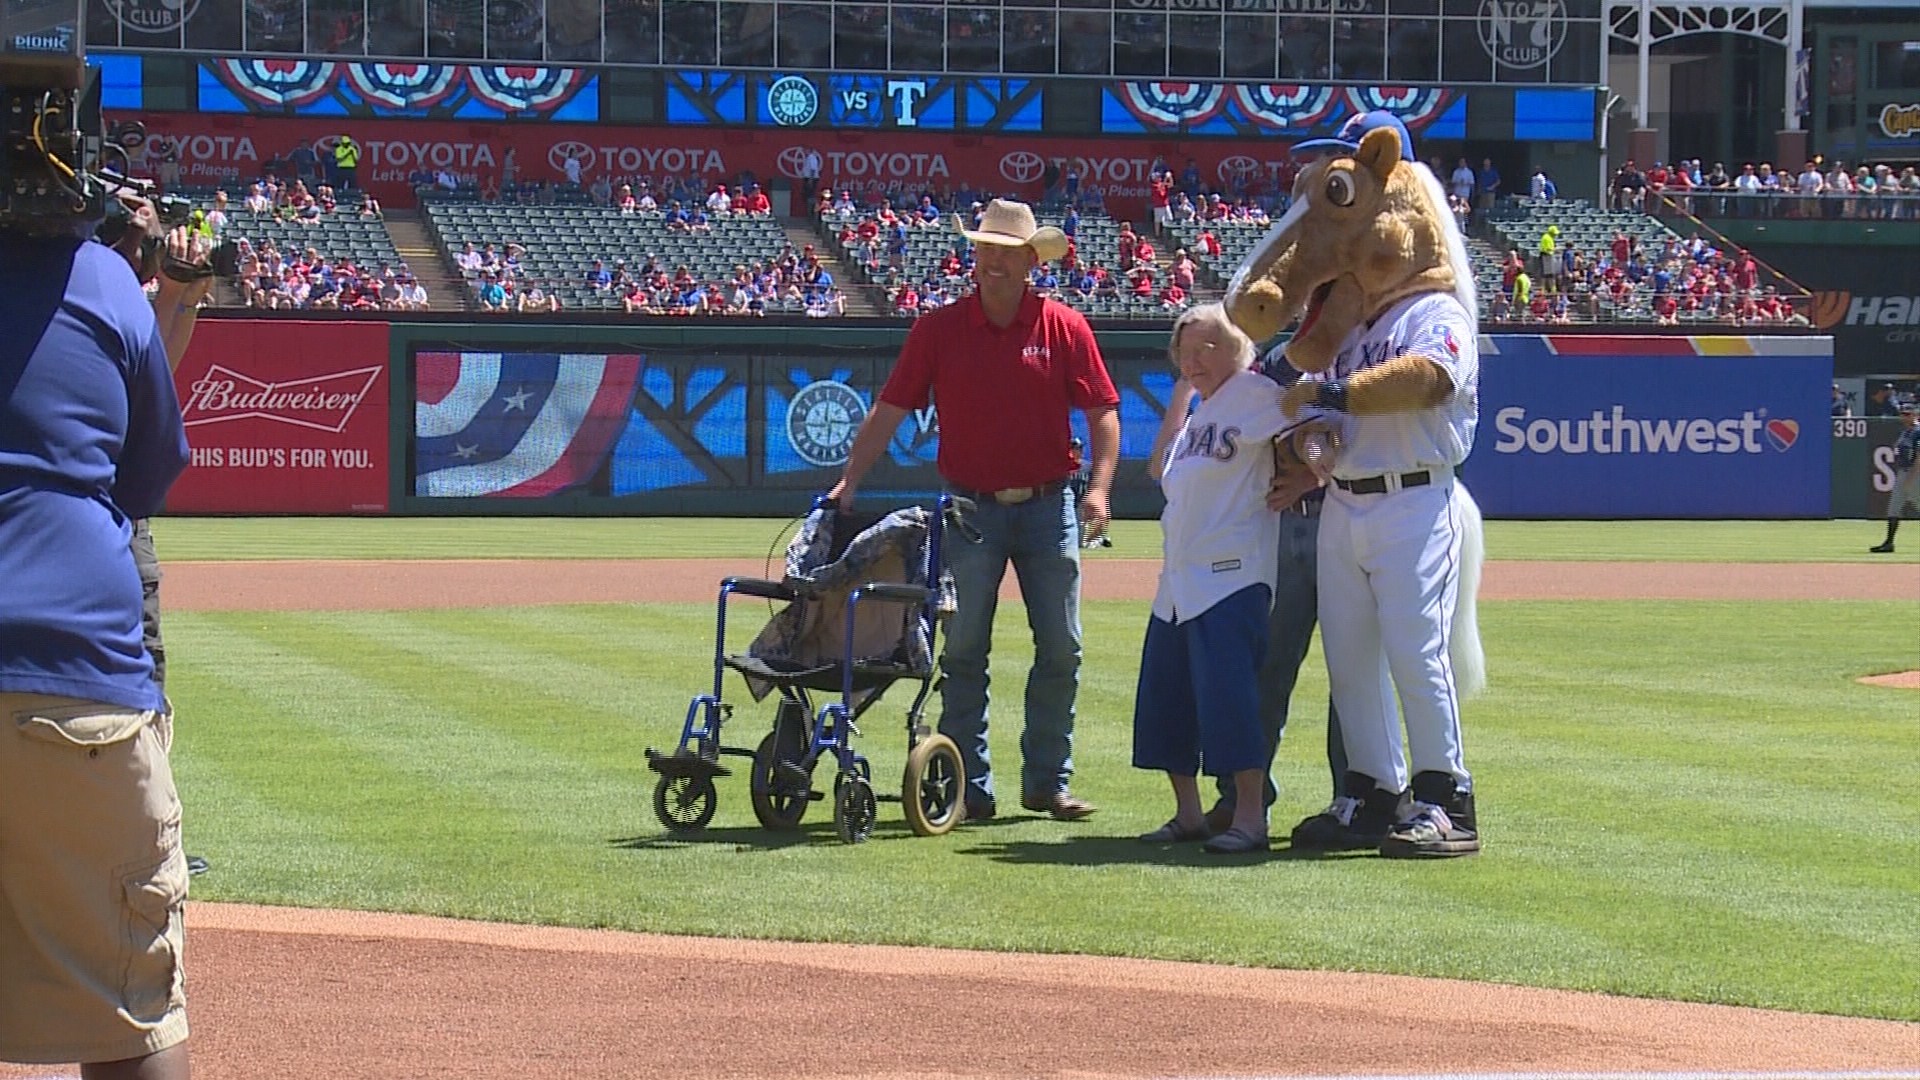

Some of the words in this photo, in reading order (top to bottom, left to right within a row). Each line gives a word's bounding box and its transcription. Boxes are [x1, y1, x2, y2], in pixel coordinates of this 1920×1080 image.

[131, 10, 172, 26] CLUB
[1503, 46, 1541, 61] CLUB
[842, 91, 868, 110] VS
[888, 81, 925, 125] T
[143, 134, 258, 161] OYOTA
[366, 140, 496, 168] TOYOTA
[190, 162, 240, 177] Places
[600, 147, 726, 173] TOYOTA
[827, 152, 949, 178] TOYOTA
[371, 168, 405, 182] Let's
[191, 380, 358, 411] Budweiser
[1494, 404, 1763, 454] Southwest
[1833, 420, 1868, 438] 390
[190, 447, 225, 468] HIS
[228, 447, 286, 469] BUD'S
[290, 448, 327, 469] FOR
[330, 449, 374, 469] YOU.
